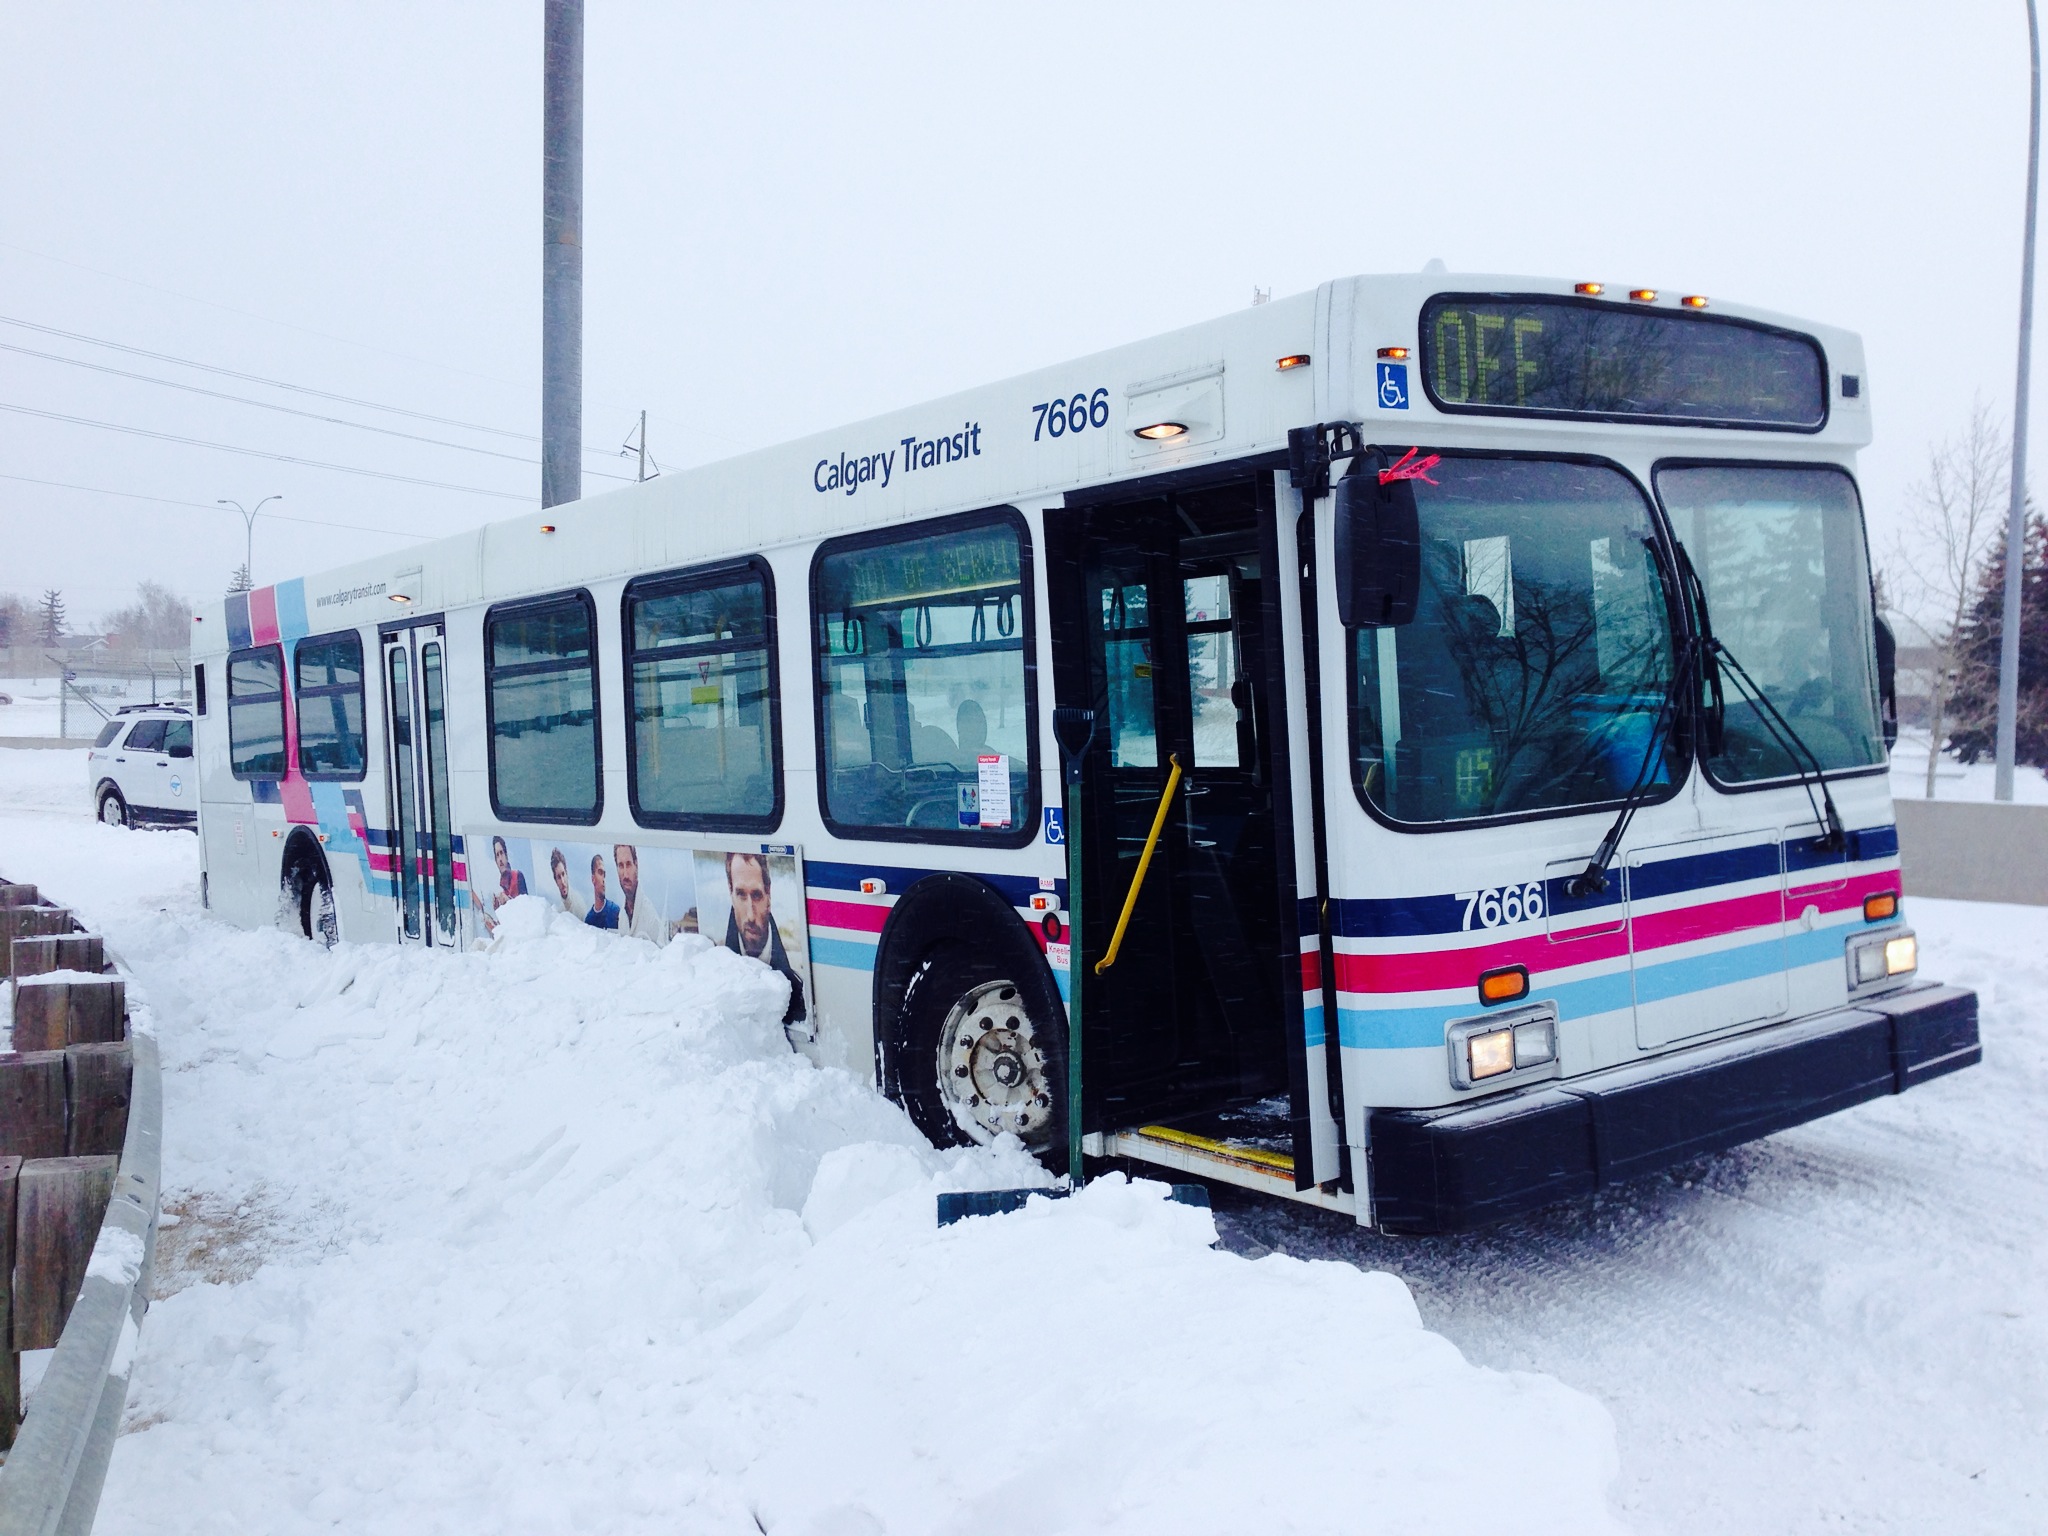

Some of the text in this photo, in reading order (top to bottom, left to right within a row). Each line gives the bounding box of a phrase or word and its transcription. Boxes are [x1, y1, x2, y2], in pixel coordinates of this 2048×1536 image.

[1436, 311, 1542, 406] OFF
[1032, 388, 1109, 442] 7666
[814, 422, 981, 496] Calgary Transit
[316, 582, 387, 608] www.calgarytransit.com
[1455, 881, 1543, 931] 7666
[1048, 945, 1070, 955] Kneelin
[1056, 955, 1068, 965] Bus
